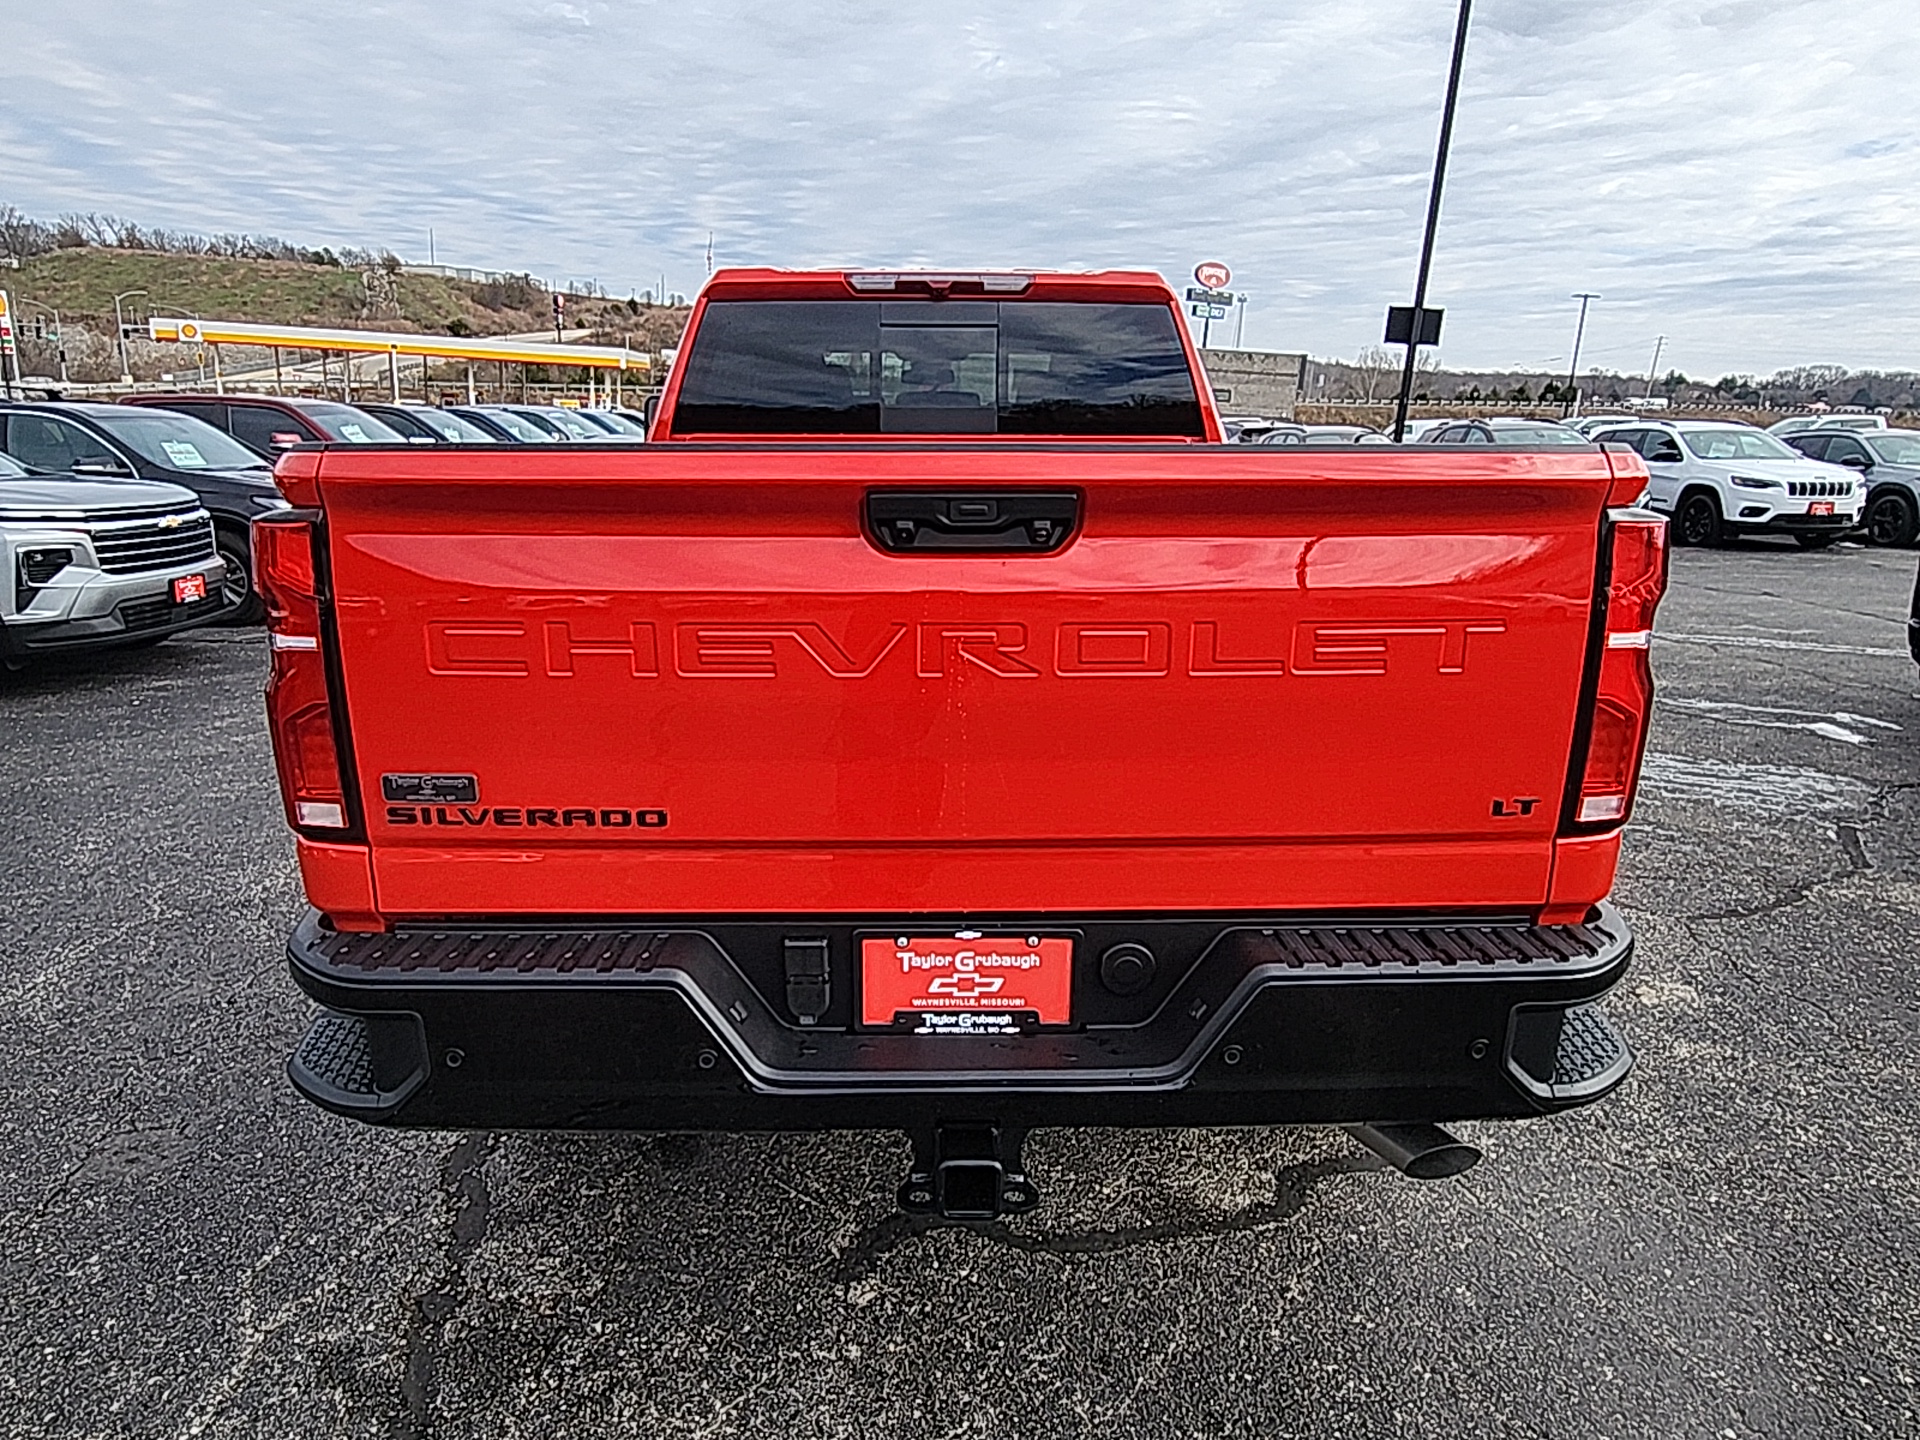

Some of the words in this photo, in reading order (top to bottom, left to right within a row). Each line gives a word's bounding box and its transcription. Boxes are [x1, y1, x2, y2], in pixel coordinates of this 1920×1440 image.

[424, 618, 1507, 678] CHEVROLET
[386, 806, 668, 828] SILVERADO
[1491, 798, 1542, 817] LT
[896, 951, 953, 972] Taylor
[954, 951, 1040, 971] Grubaugh
[921, 1013, 958, 1027] Taylor
[958, 1013, 1013, 1027] Grubaugh
